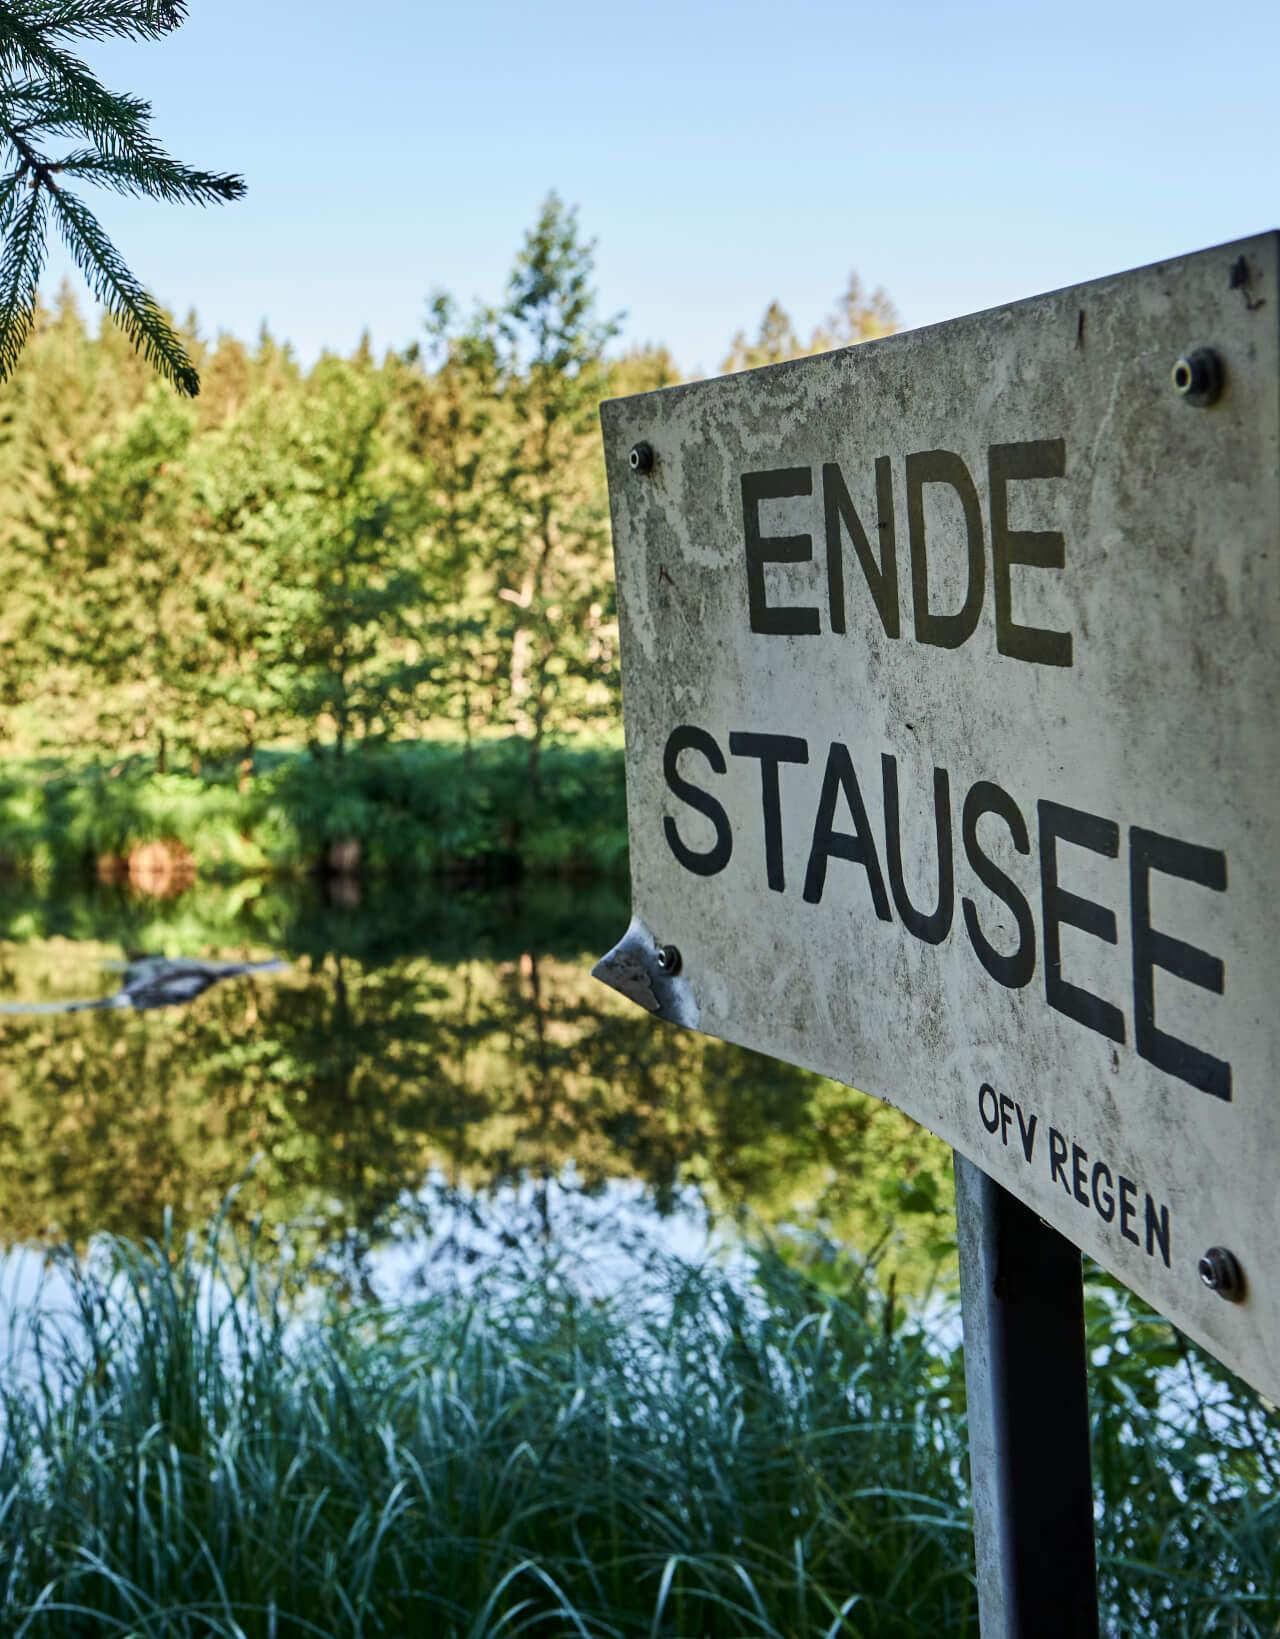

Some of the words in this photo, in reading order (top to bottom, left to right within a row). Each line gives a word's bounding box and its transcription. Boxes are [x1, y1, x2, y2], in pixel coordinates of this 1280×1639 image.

[740, 438, 1073, 667] ENDE
[663, 725, 1232, 1102] STAUSEE
[978, 1082, 1037, 1163] OFV
[1049, 1127, 1171, 1268] REGEN
